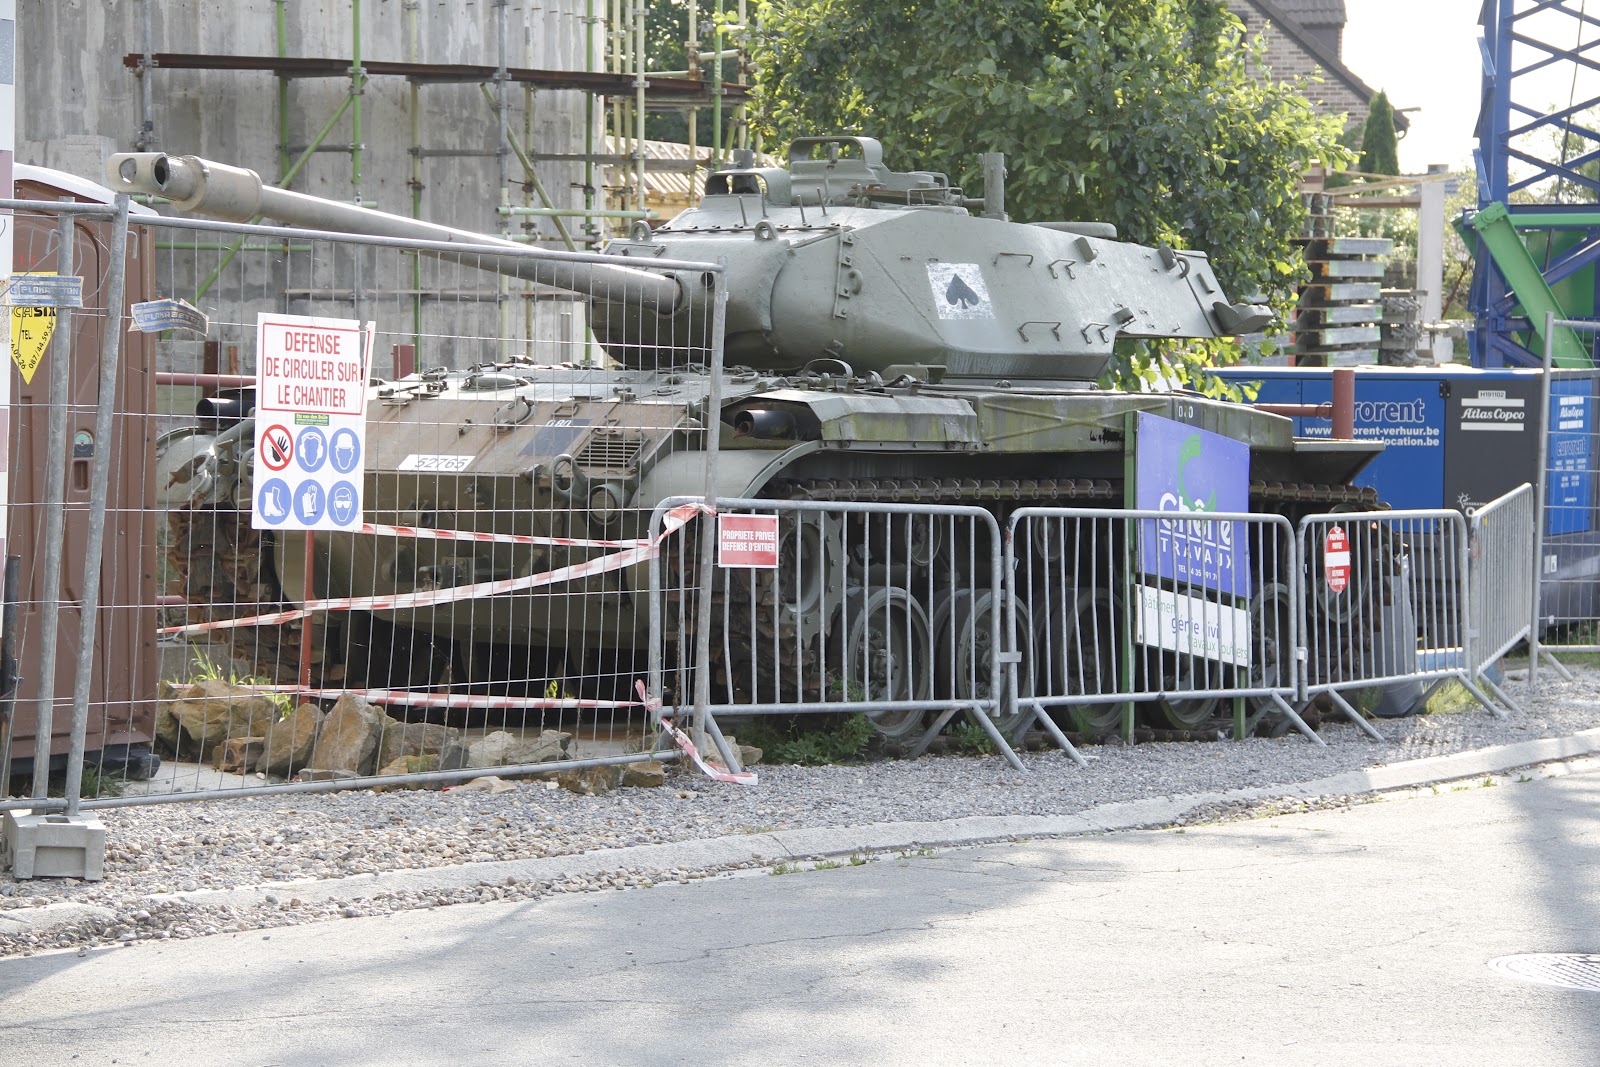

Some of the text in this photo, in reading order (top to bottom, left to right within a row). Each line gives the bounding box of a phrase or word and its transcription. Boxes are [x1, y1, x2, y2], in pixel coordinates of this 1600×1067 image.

[285, 331, 341, 355] DEFENSE
[265, 356, 358, 382] DE CIRCULER SUR
[277, 384, 346, 408] LE CHANTIER
[1321, 398, 1425, 422] rorent
[1461, 407, 1525, 421] Atlas Copco
[414, 457, 469, 469] 52765
[722, 530, 775, 541] PROPRIETE PRIVEE
[722, 541, 776, 552] DEFENSE D'ENTRER
